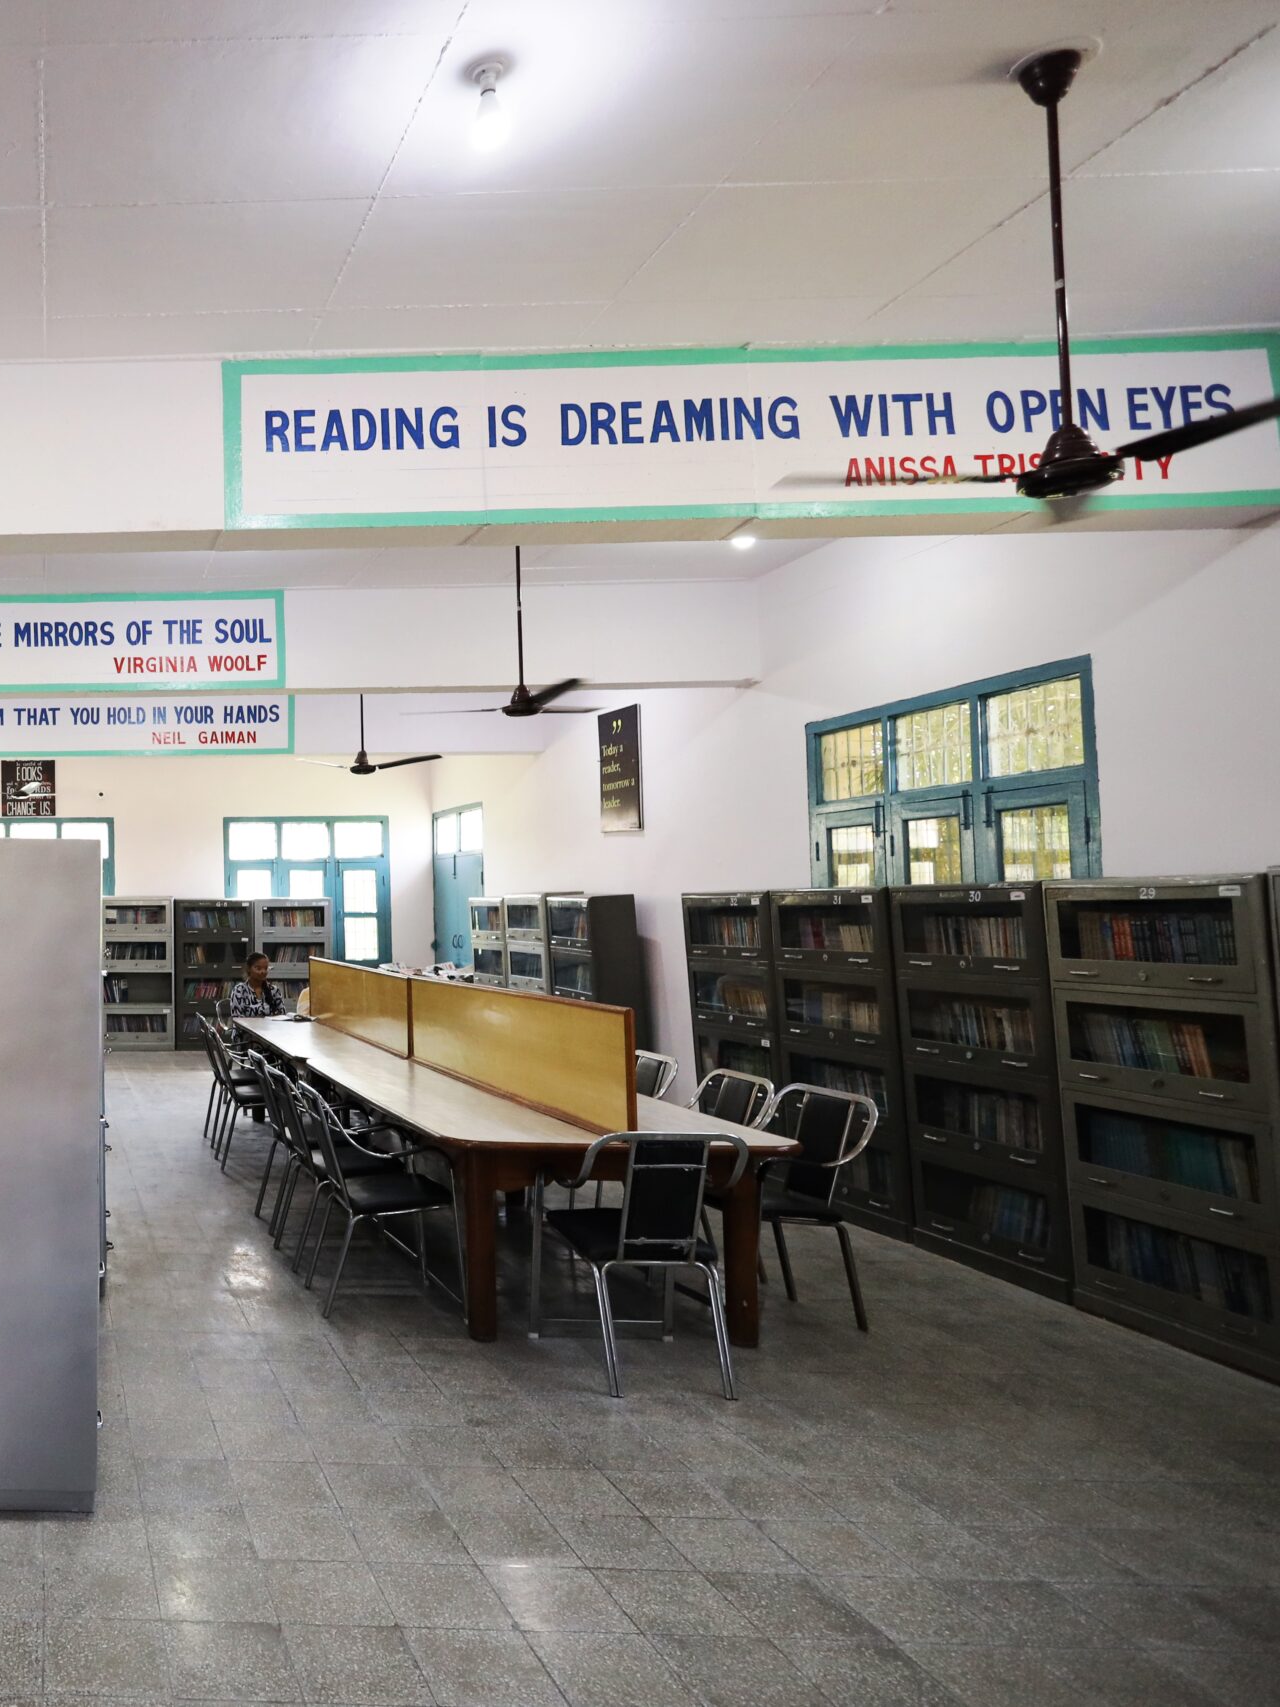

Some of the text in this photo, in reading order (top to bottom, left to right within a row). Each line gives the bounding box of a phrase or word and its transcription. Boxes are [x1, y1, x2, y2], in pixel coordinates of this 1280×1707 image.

[264, 406, 460, 453] READING
[487, 404, 527, 448] IS
[560, 396, 801, 446] DREAMING
[830, 392, 956, 438] WITH
[1126, 383, 1235, 430] EYES
[845, 454, 958, 487] ANISSA
[13, 620, 115, 648] MIRRORS
[126, 619, 153, 647] OF
[162, 618, 203, 645] THE
[214, 617, 272, 645] SOUL
[113, 654, 267, 674] VIRGINIA WOOLF
[13, 707, 60, 726] THAT
[70, 707, 100, 726] YOU
[107, 706, 146, 725] HOLD
[152, 707, 167, 725] IN
[174, 705, 214, 725] YOUR
[223, 704, 280, 725] HANDS
[151, 730, 257, 745] NEIL GAIMAN
[7, 802, 36, 815] CHANGE
[833, 895, 842, 905] 31
[968, 890, 981, 902] 30
[1139, 887, 1156, 899] 29
